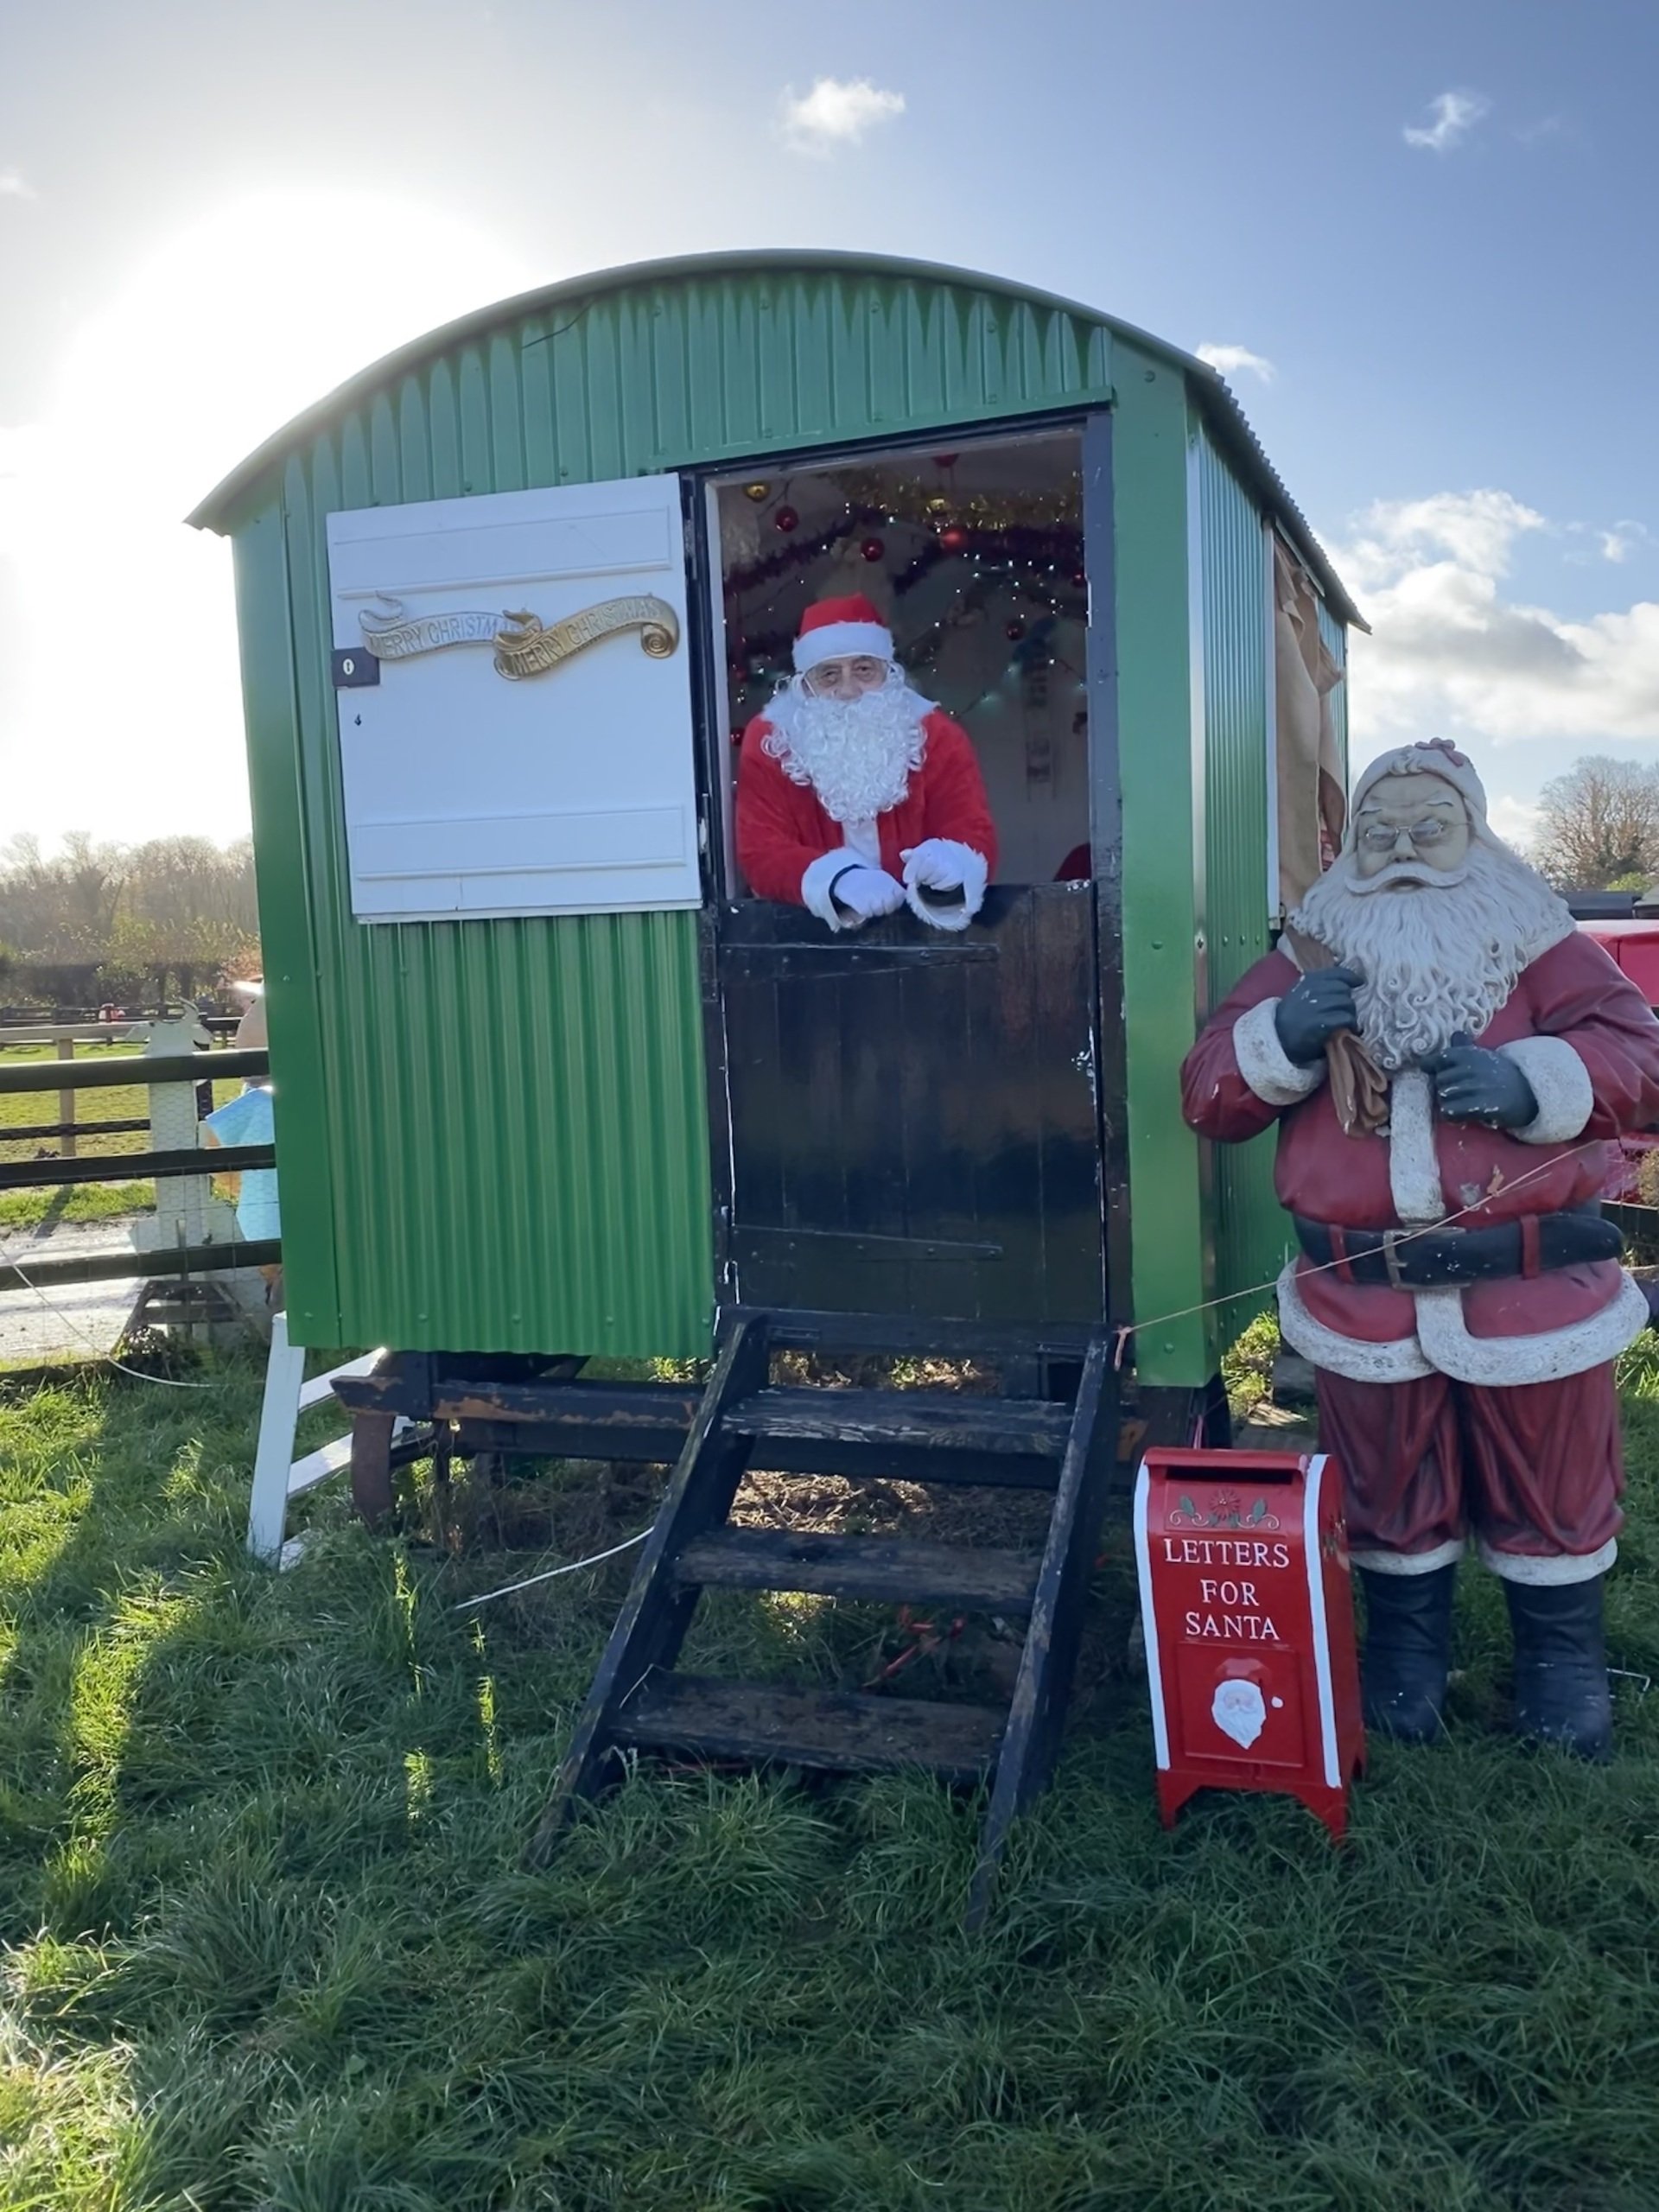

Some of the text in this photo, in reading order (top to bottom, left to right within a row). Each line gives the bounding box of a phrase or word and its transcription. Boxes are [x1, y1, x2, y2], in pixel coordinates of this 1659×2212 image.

[369, 616, 522, 657] MERRY CHRISTMA
[511, 598, 660, 674] MERRY CHRISTMAS
[1163, 1538, 1290, 1568] LETTERS
[1201, 1580, 1259, 1606] FOR
[1185, 1611, 1281, 1641] SANTA
